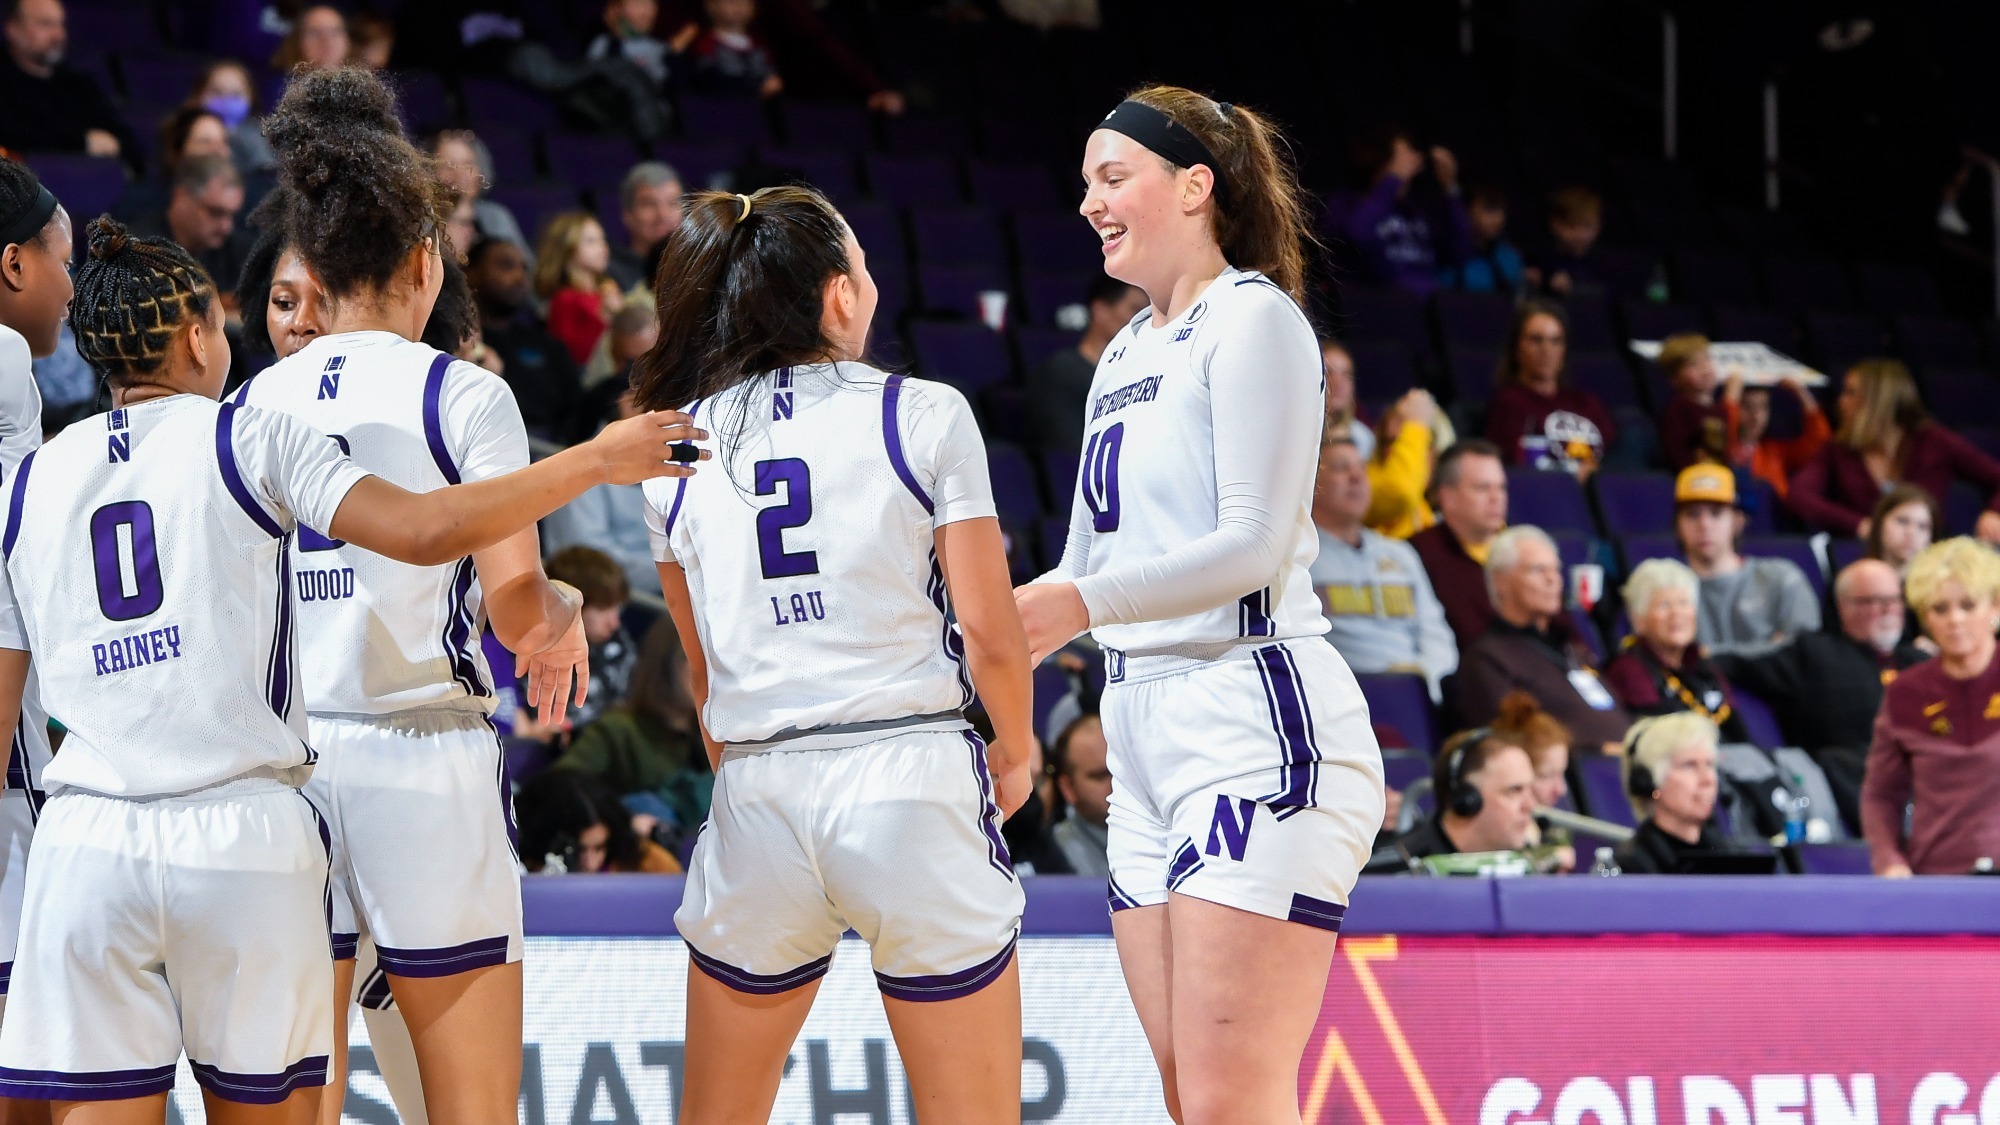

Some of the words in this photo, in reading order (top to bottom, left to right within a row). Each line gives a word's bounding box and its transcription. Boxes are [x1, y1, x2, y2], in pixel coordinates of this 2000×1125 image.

[317, 373, 341, 400] N
[773, 392, 794, 421] N
[108, 432, 131, 463] N
[1082, 421, 1124, 533] 10
[754, 457, 820, 580] 2
[90, 500, 164, 621] 0
[296, 567, 355, 602] WOOD
[770, 590, 826, 626] LAU
[91, 625, 181, 677] RAINEY
[1204, 794, 1258, 863] N
